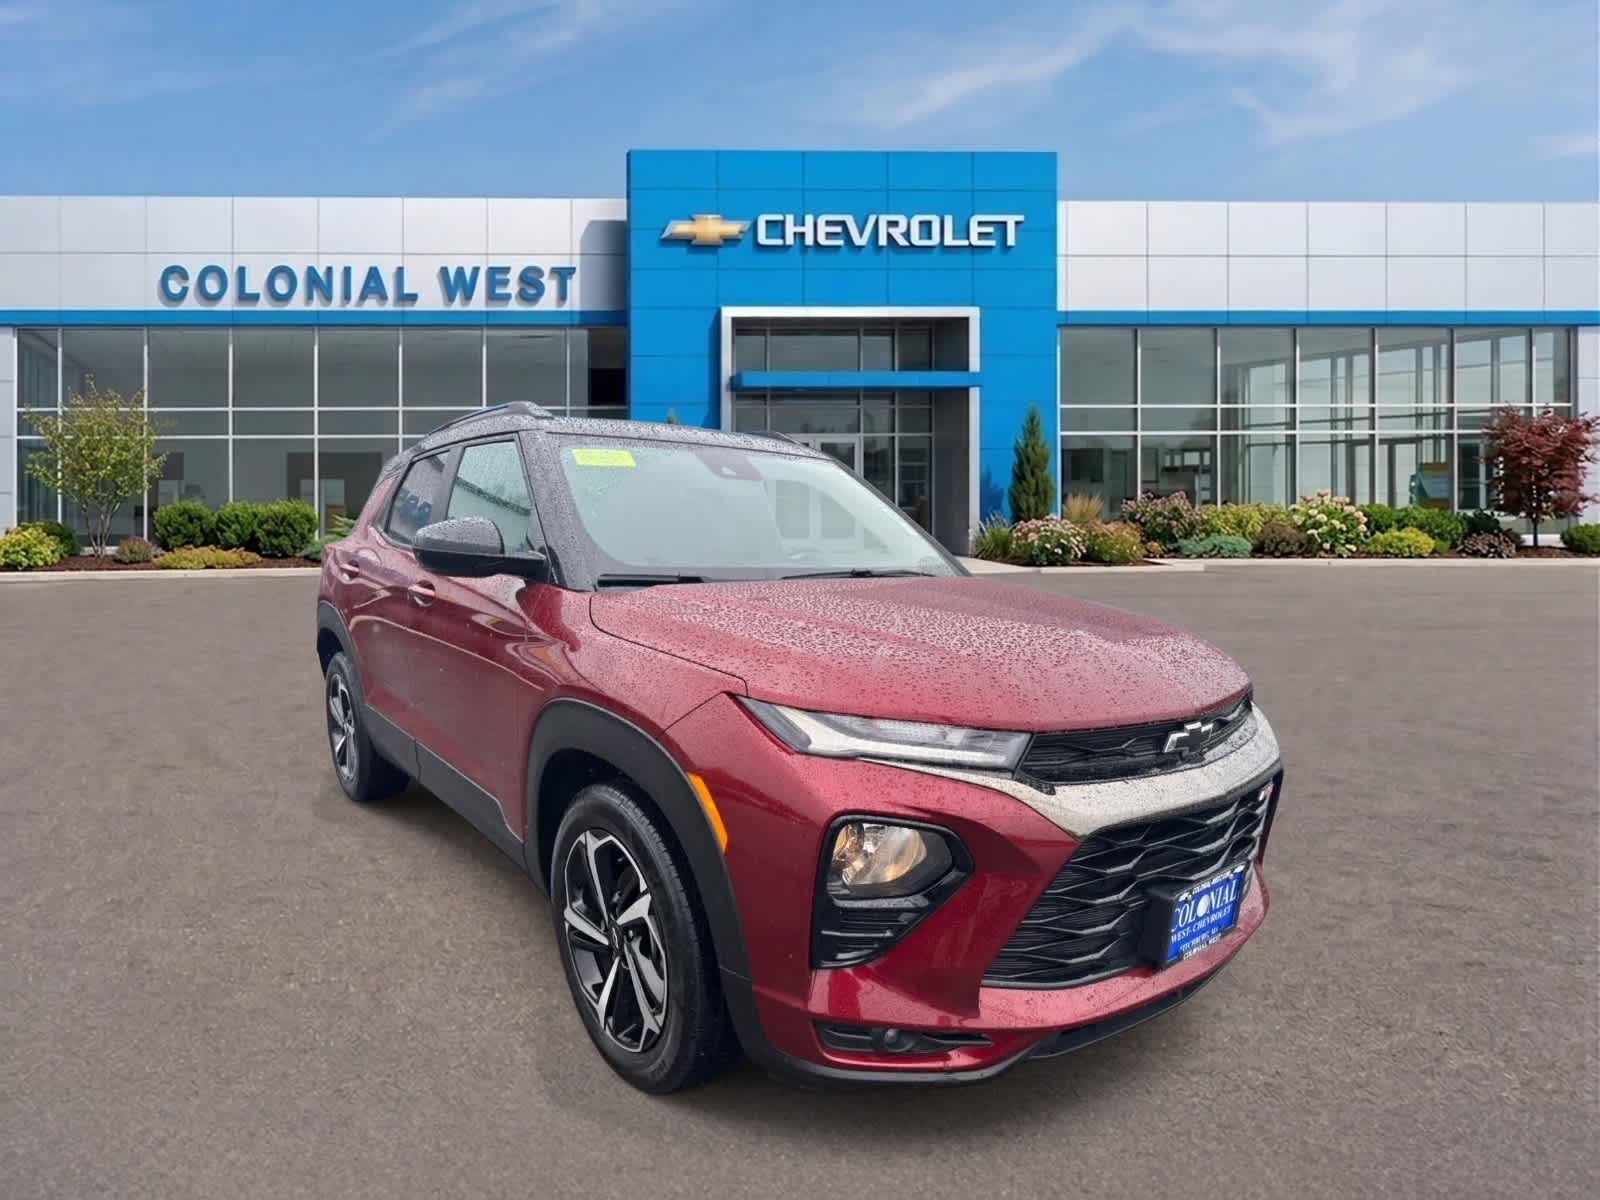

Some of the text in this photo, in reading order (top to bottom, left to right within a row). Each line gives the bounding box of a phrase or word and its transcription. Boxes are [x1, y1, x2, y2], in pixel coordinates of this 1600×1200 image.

[757, 214, 1024, 247] CHEVROLET
[160, 265, 577, 302] COLONIAL WEST
[1192, 905, 1232, 932] CHEVROLET
